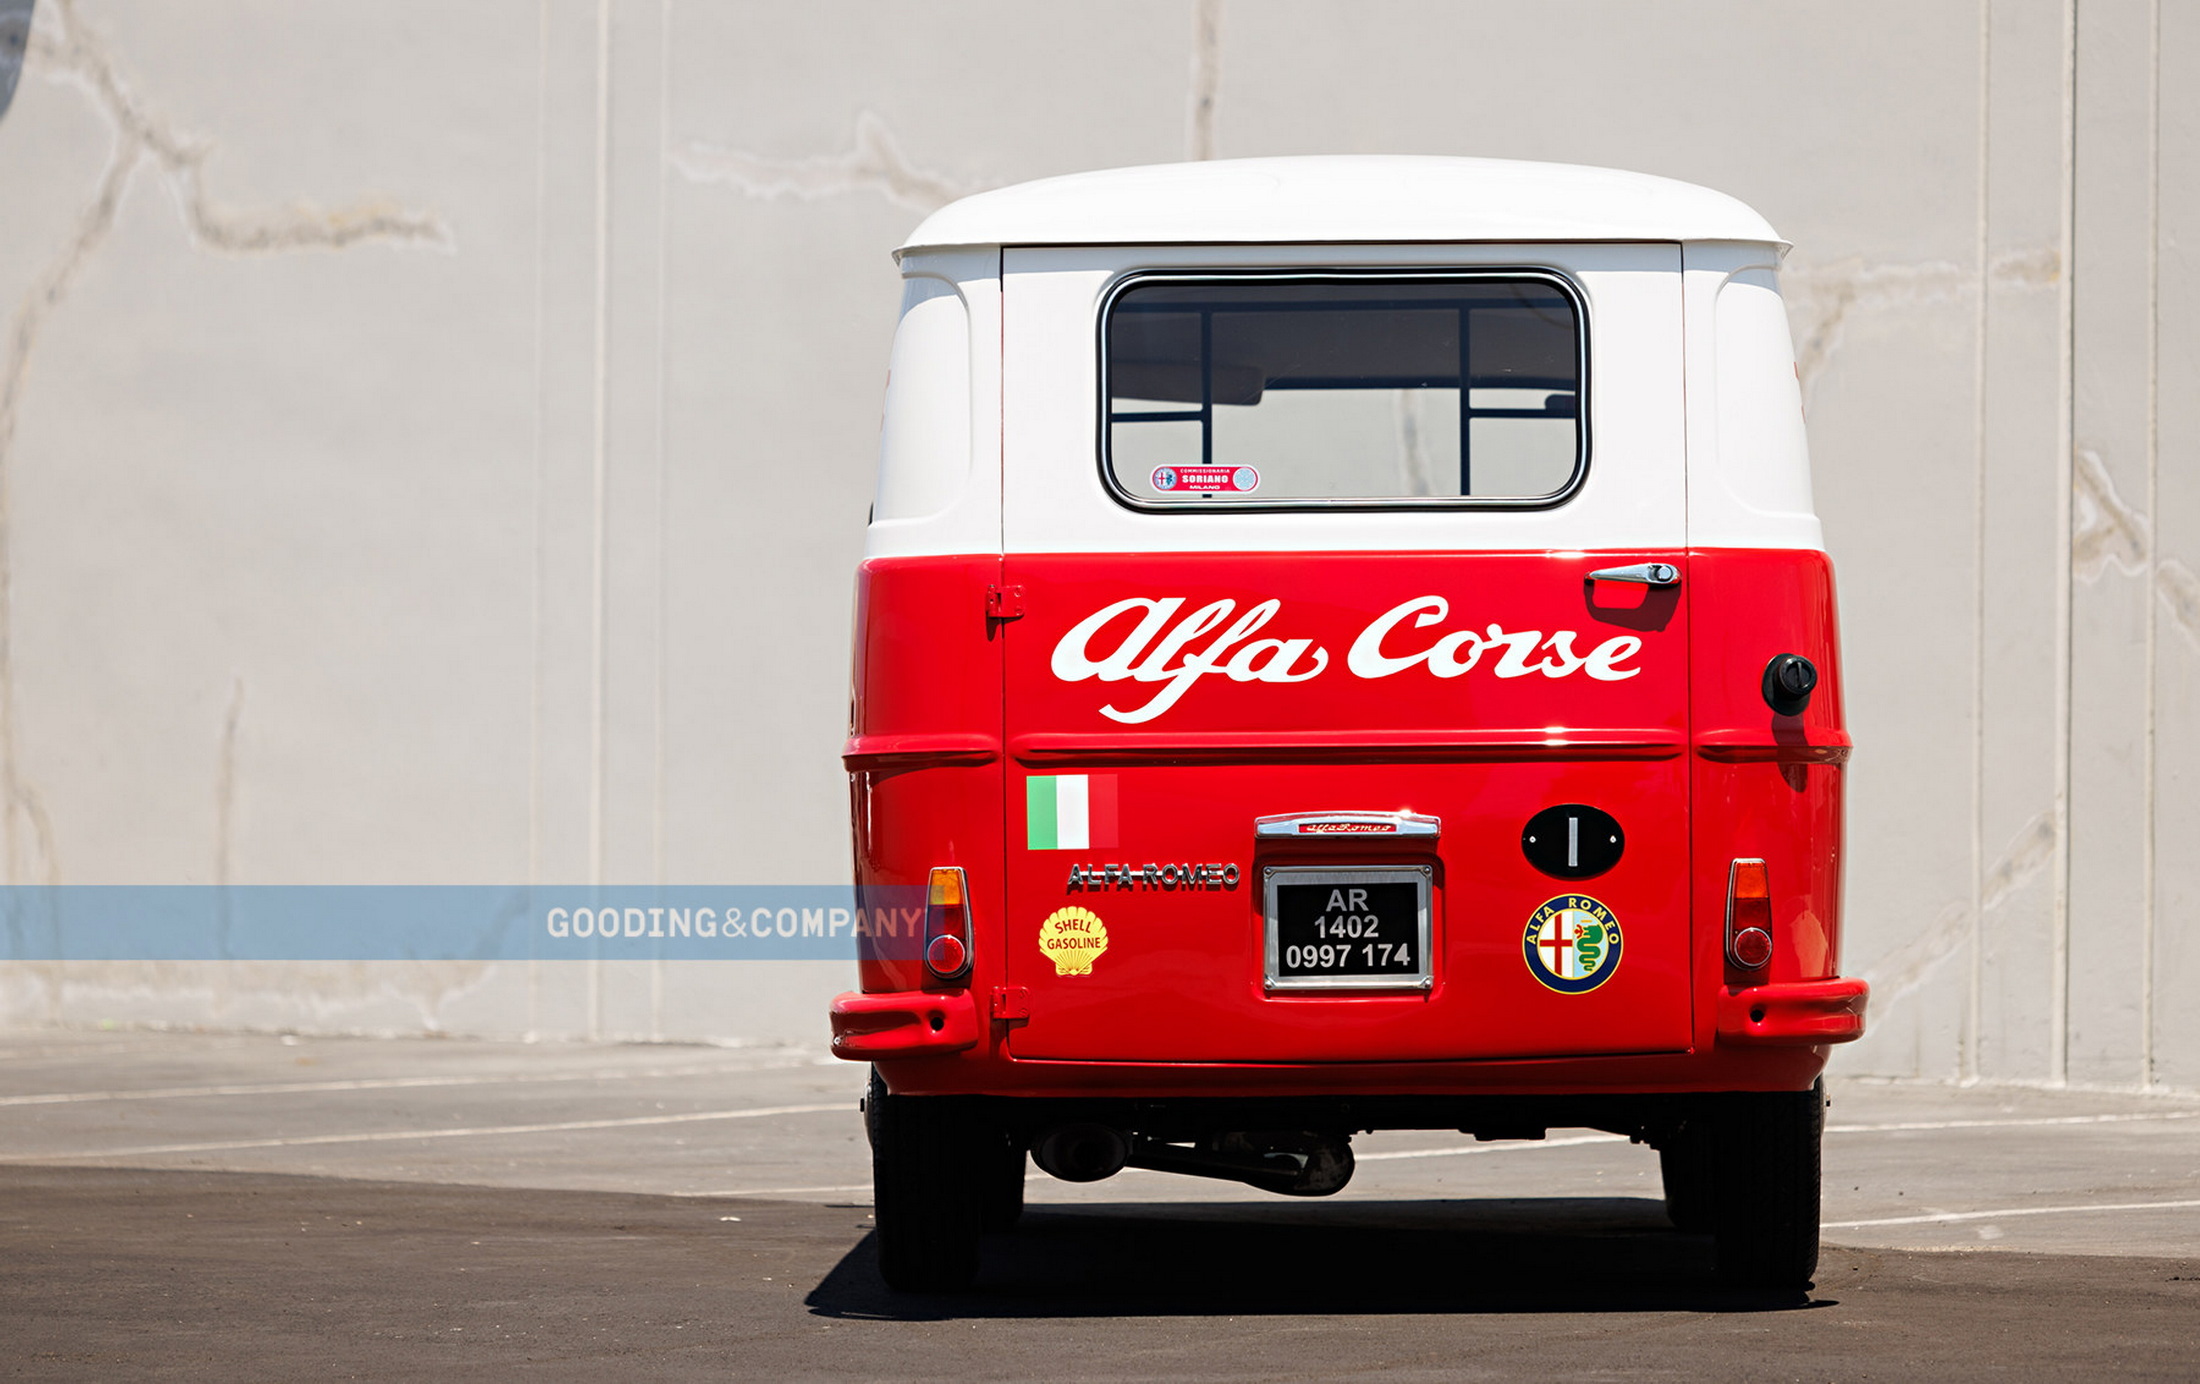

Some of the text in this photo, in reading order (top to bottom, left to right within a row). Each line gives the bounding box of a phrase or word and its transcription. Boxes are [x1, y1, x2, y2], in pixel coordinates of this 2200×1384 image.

[1181, 474, 1229, 484] SORIANO
[1346, 594, 1643, 681] Corse
[1067, 862, 1241, 886] ALFA ROMEO
[1325, 888, 1369, 912] AR
[1054, 918, 1092, 935] SHELL
[1314, 915, 1379, 939] 1402
[1526, 897, 1620, 945] ALFA ROMEO
[1047, 936, 1101, 950] GASOLINE
[1286, 943, 1411, 969] 0997 174
